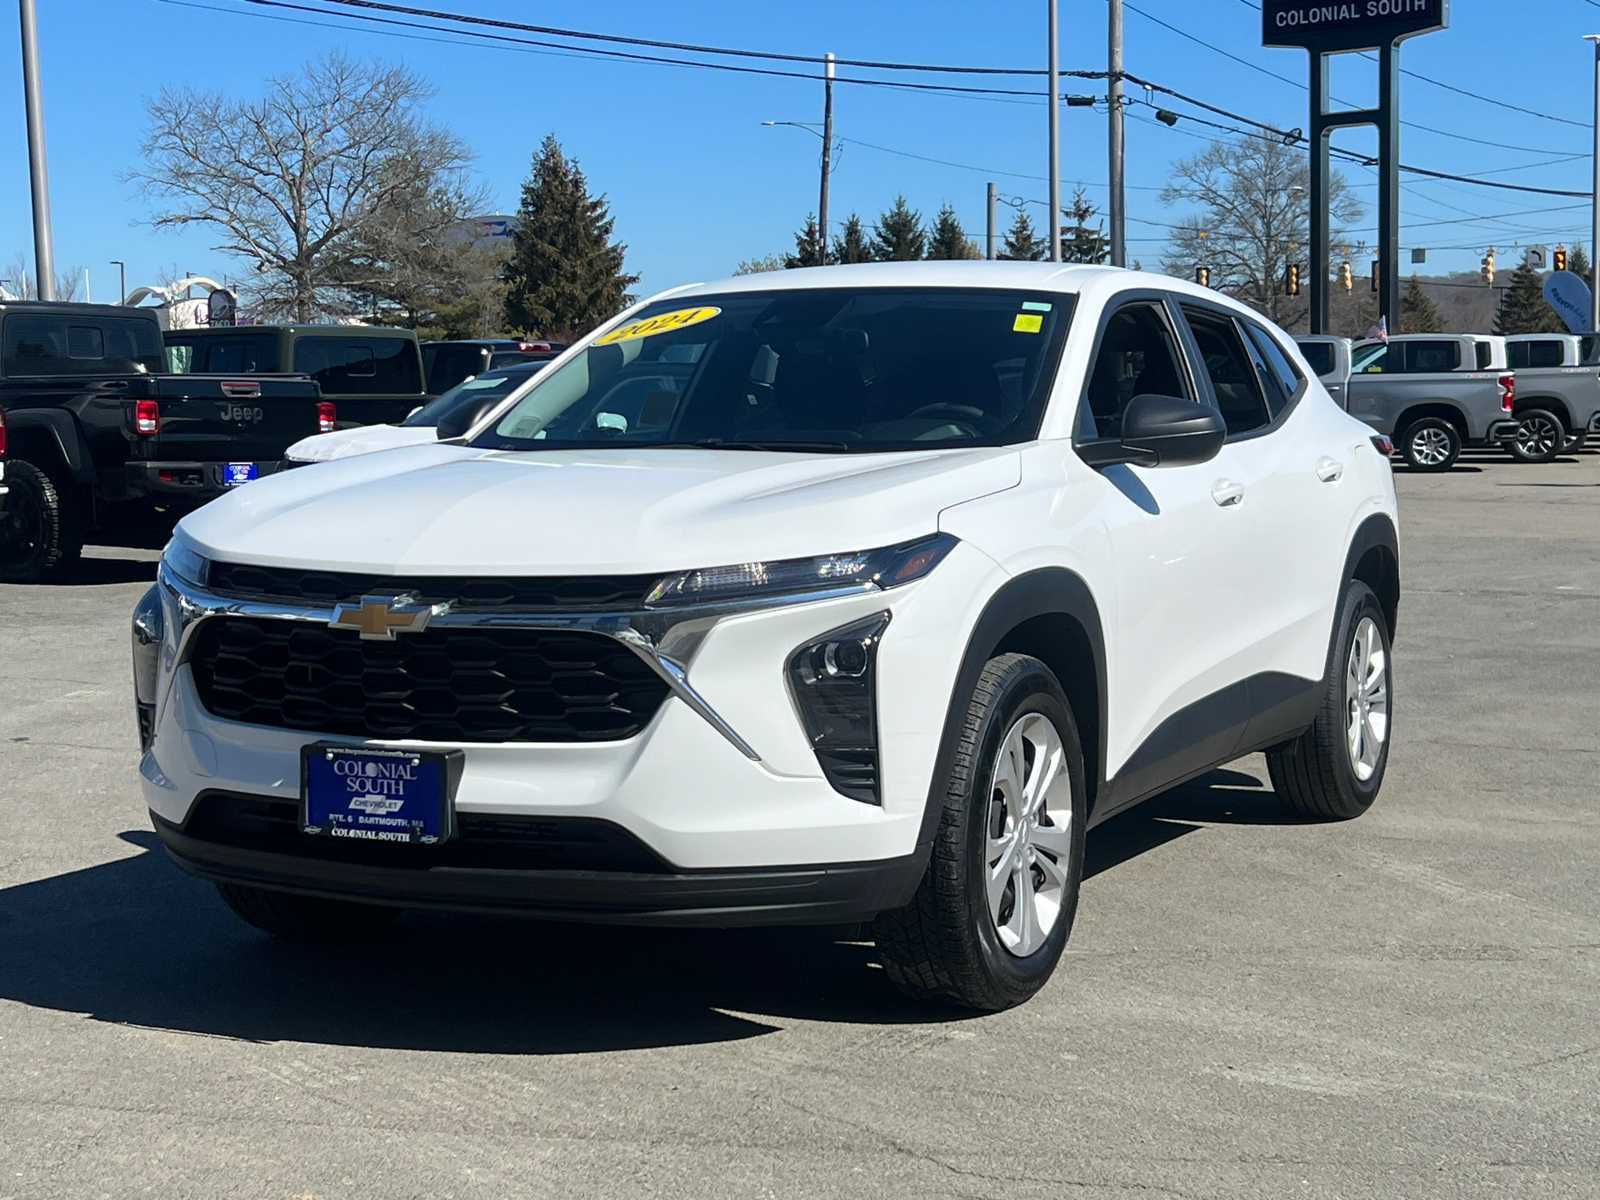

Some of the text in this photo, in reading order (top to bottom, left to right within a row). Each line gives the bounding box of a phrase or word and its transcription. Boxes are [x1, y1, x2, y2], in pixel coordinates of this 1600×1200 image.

[1276, 0, 1426, 27] COLONIAL SOUTH
[608, 309, 702, 341] 2024
[220, 402, 264, 425] Jeep
[334, 760, 417, 780] COLONIAL
[347, 777, 404, 795] SOUTH
[353, 799, 399, 809] CHEVROLET
[347, 815, 353, 823] 6
[331, 827, 410, 842] COLONIAL SOUTH
